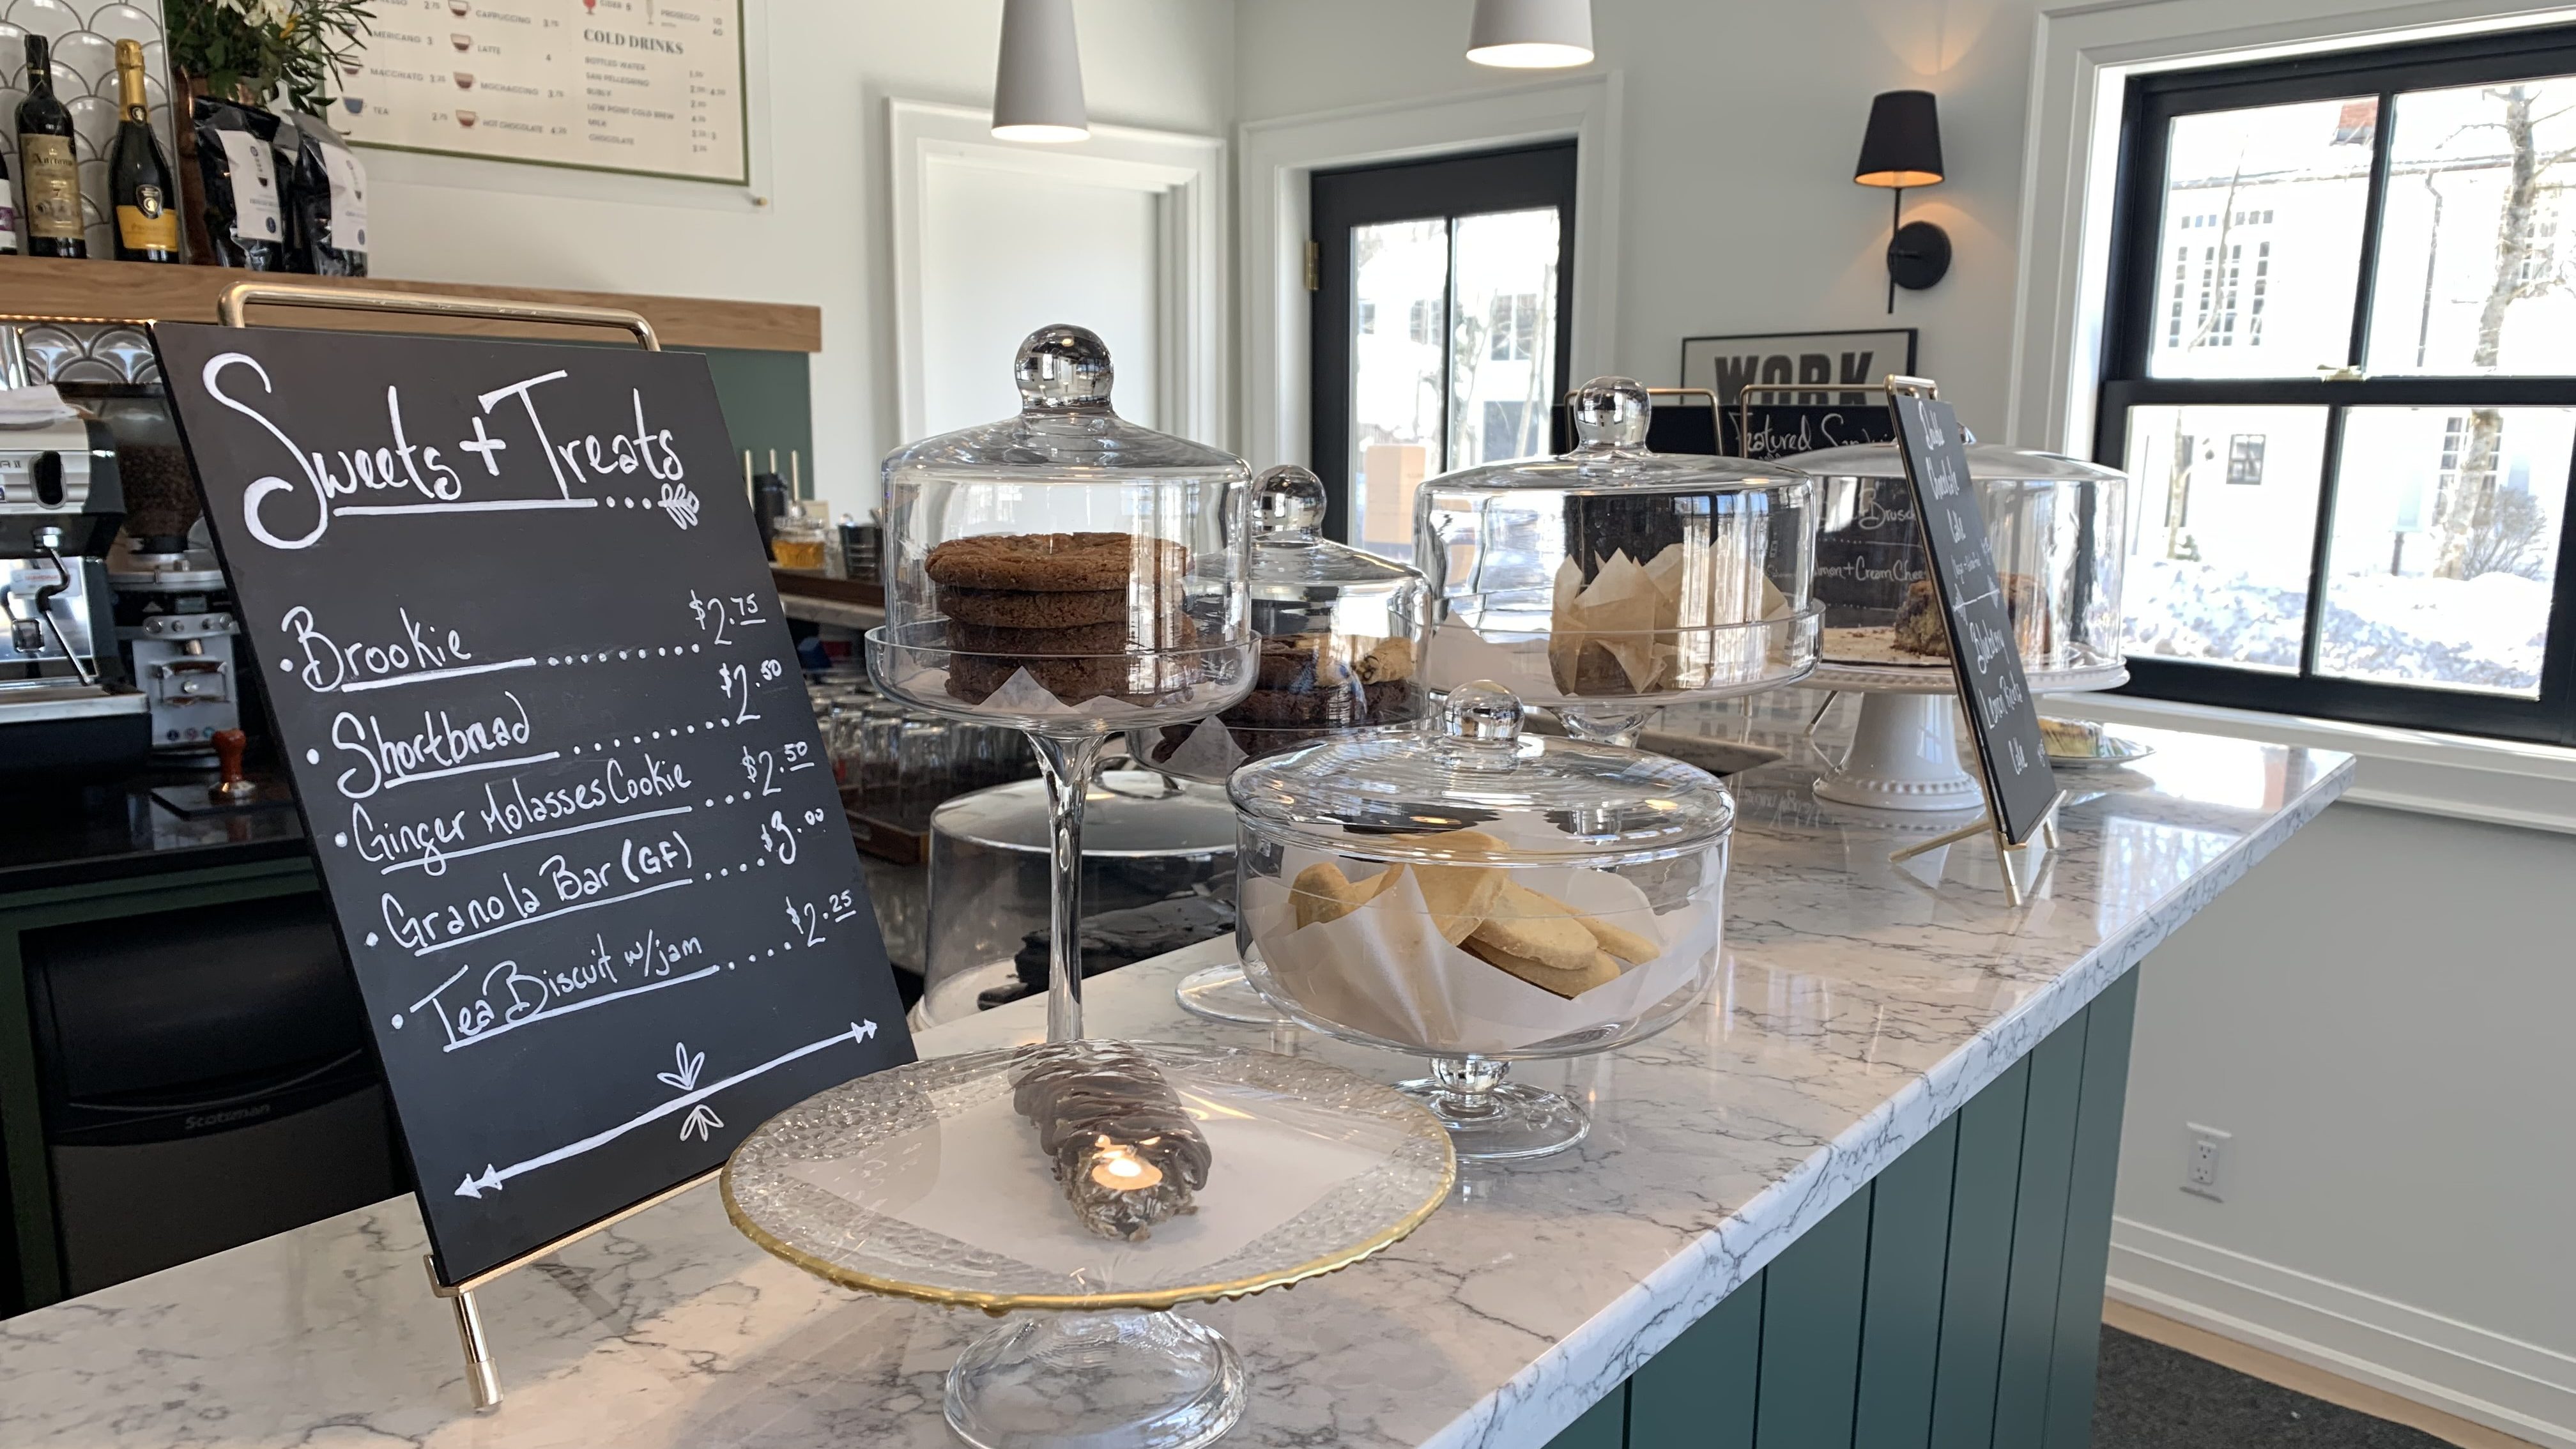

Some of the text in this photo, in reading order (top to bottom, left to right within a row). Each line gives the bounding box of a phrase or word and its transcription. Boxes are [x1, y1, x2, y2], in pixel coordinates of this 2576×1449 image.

[372, 31, 422, 43] MERICANO
[475, 10, 532, 24] CAPPUCCINO
[477, 45, 501, 55] LATTE
[583, 28, 684, 55] COLD DRINKS
[373, 106, 389, 116] TEA
[1715, 351, 1874, 405] WORK
[203, 353, 461, 549] Sweets
[478, 370, 684, 501] Treats
[1855, 555, 1895, 581] Cream
[281, 606, 472, 693] Brookie
[332, 691, 530, 799] Shortbread
[352, 802, 465, 877] Ginger
[480, 776, 606, 836] Molasses
[606, 753, 692, 804] Cookie
[381, 872, 541, 950] Granola
[539, 854, 611, 901] Bar
[621, 831, 693, 883] (GF)
[409, 963, 495, 1050] Tea
[482, 933, 618, 1024] Biscuit
[624, 928, 703, 979] w/jam
[185, 1103, 271, 1130] Scotsman
